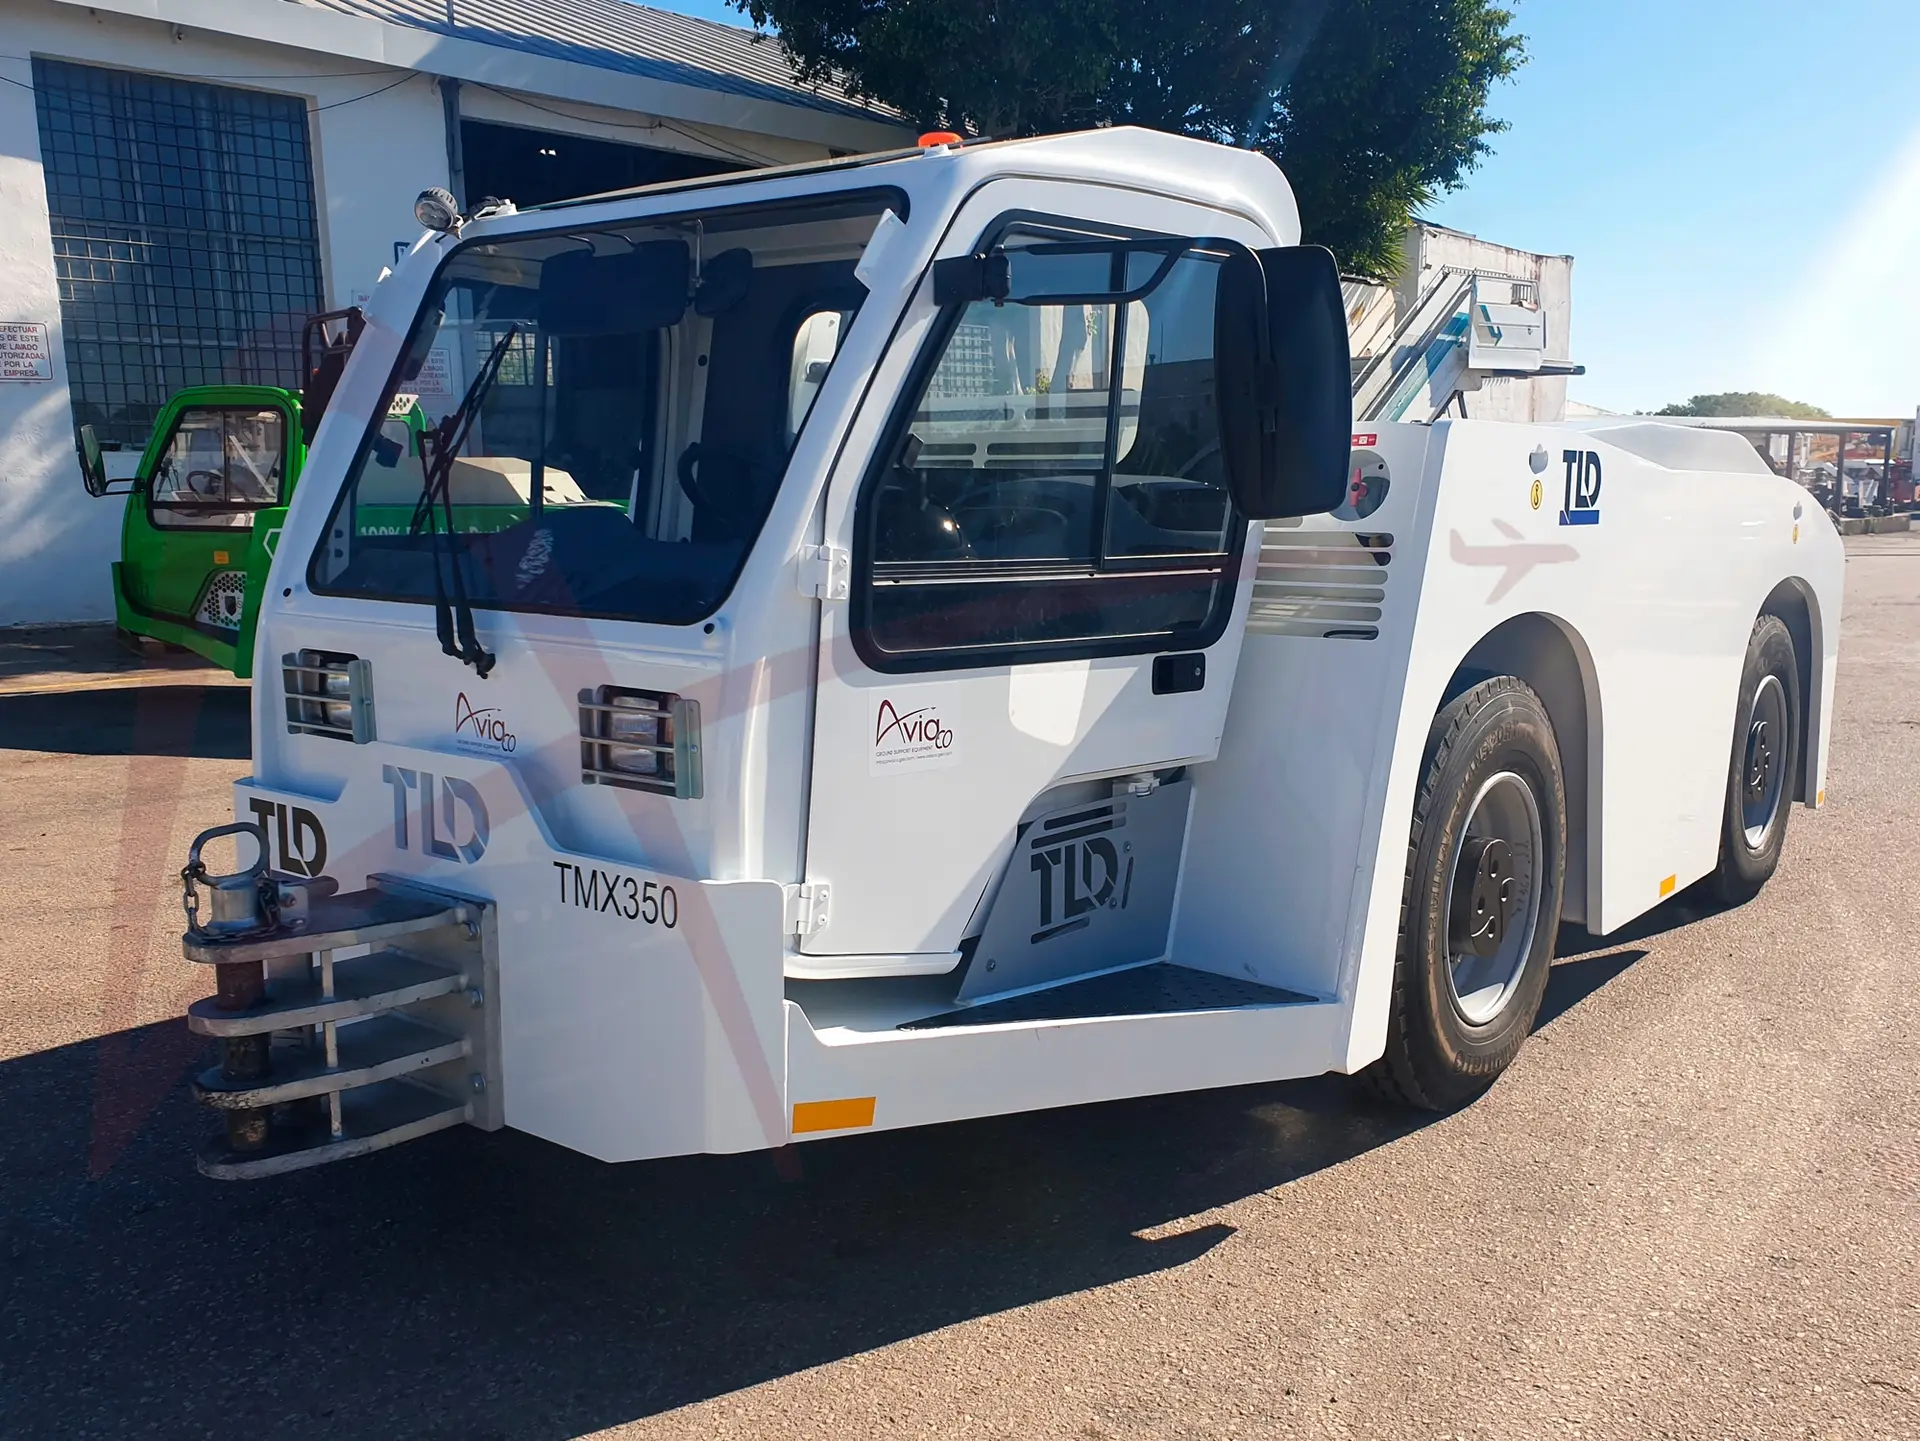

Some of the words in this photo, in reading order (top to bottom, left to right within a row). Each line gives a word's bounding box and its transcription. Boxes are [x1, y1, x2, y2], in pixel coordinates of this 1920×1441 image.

[0, 325, 38, 333] EFECTUAR
[9, 343, 38, 351] LAVADO
[1561, 449, 1602, 523] TLD
[876, 699, 953, 749] Aviaco
[249, 796, 327, 878] TLD
[382, 763, 490, 865] TLD
[553, 861, 678, 928] TMX350
[1030, 837, 1119, 927] TLD
